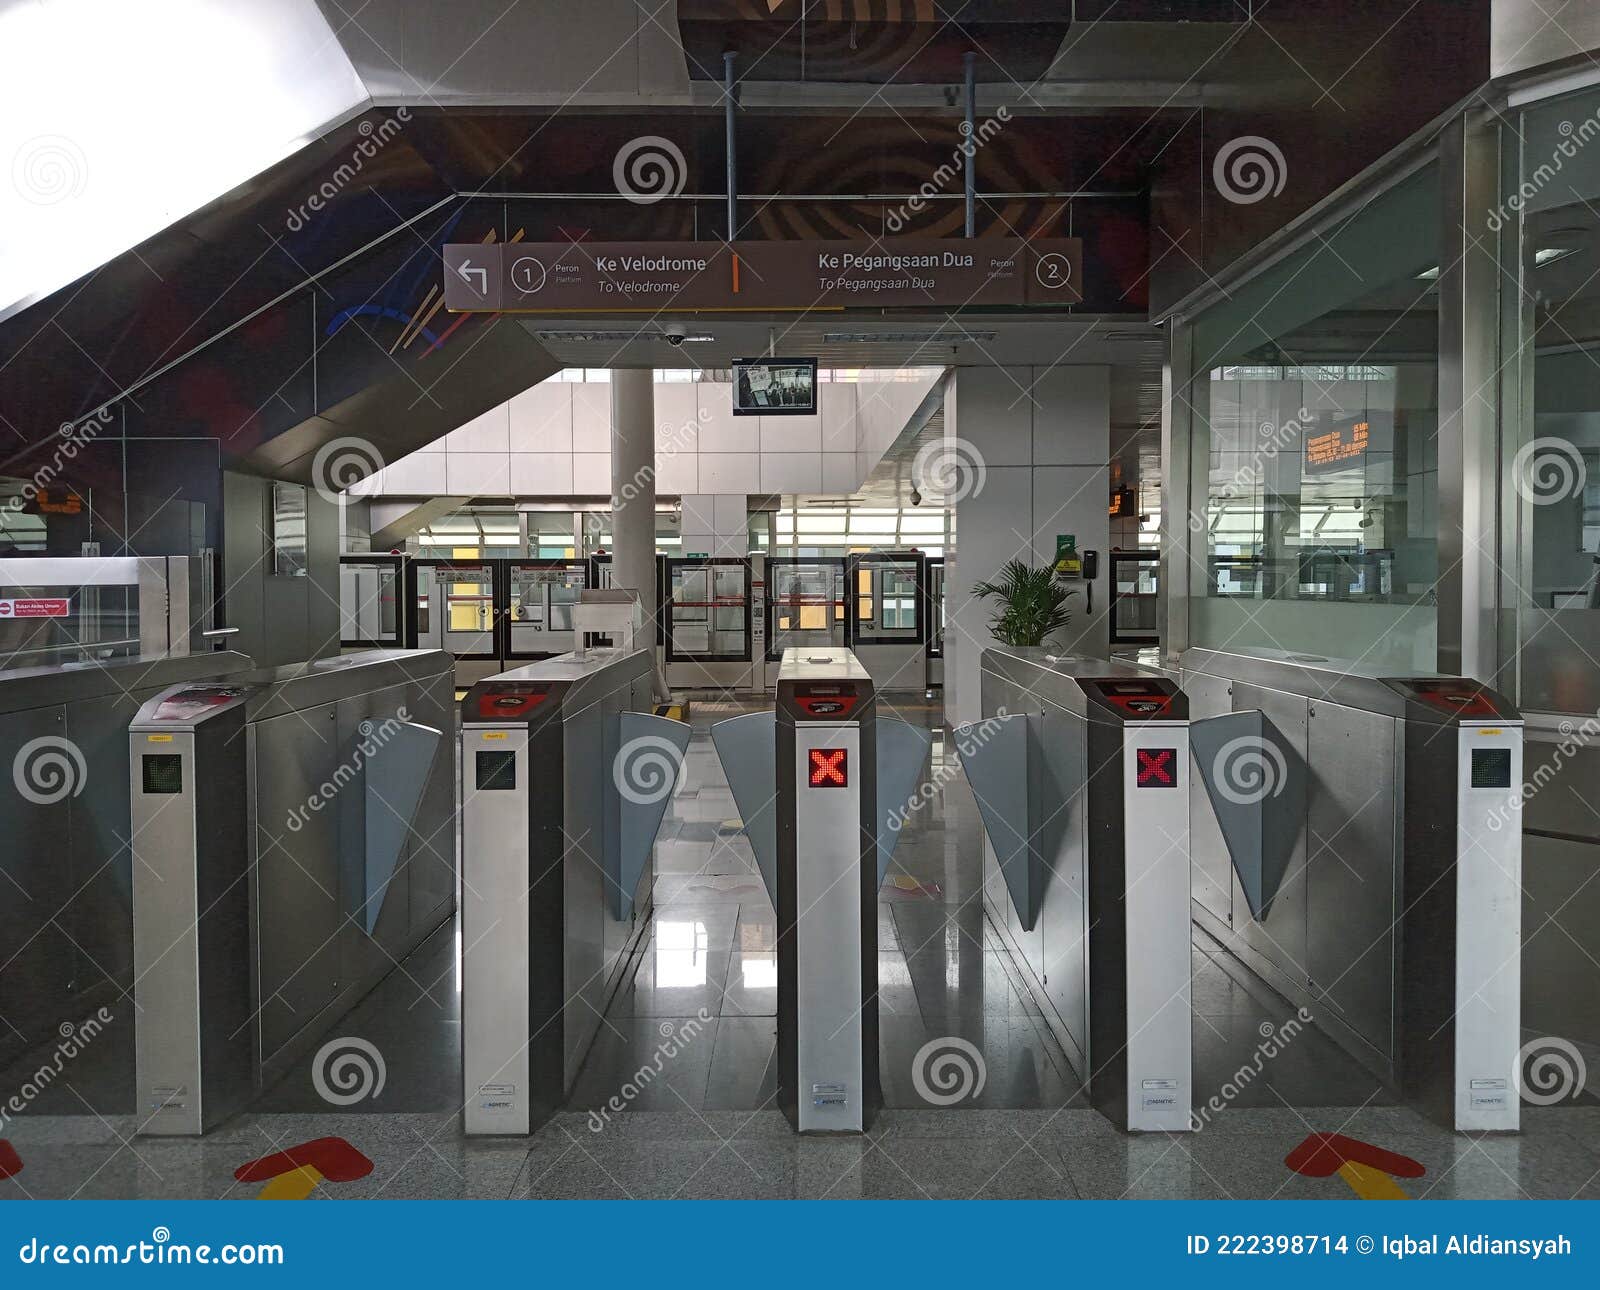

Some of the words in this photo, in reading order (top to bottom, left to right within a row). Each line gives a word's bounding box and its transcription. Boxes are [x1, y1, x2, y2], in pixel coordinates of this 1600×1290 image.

[555, 264, 580, 273] Peron
[596, 256, 617, 272] Ke
[620, 255, 706, 272] Velodrome
[818, 253, 839, 269] Ke
[843, 253, 939, 272] Pegangsaan
[943, 252, 974, 267] Dua
[598, 280, 613, 293] To
[616, 279, 680, 293] Velodrome
[819, 277, 834, 290] To
[837, 277, 909, 292] Pegangsaan
[911, 276, 935, 288] Dua
